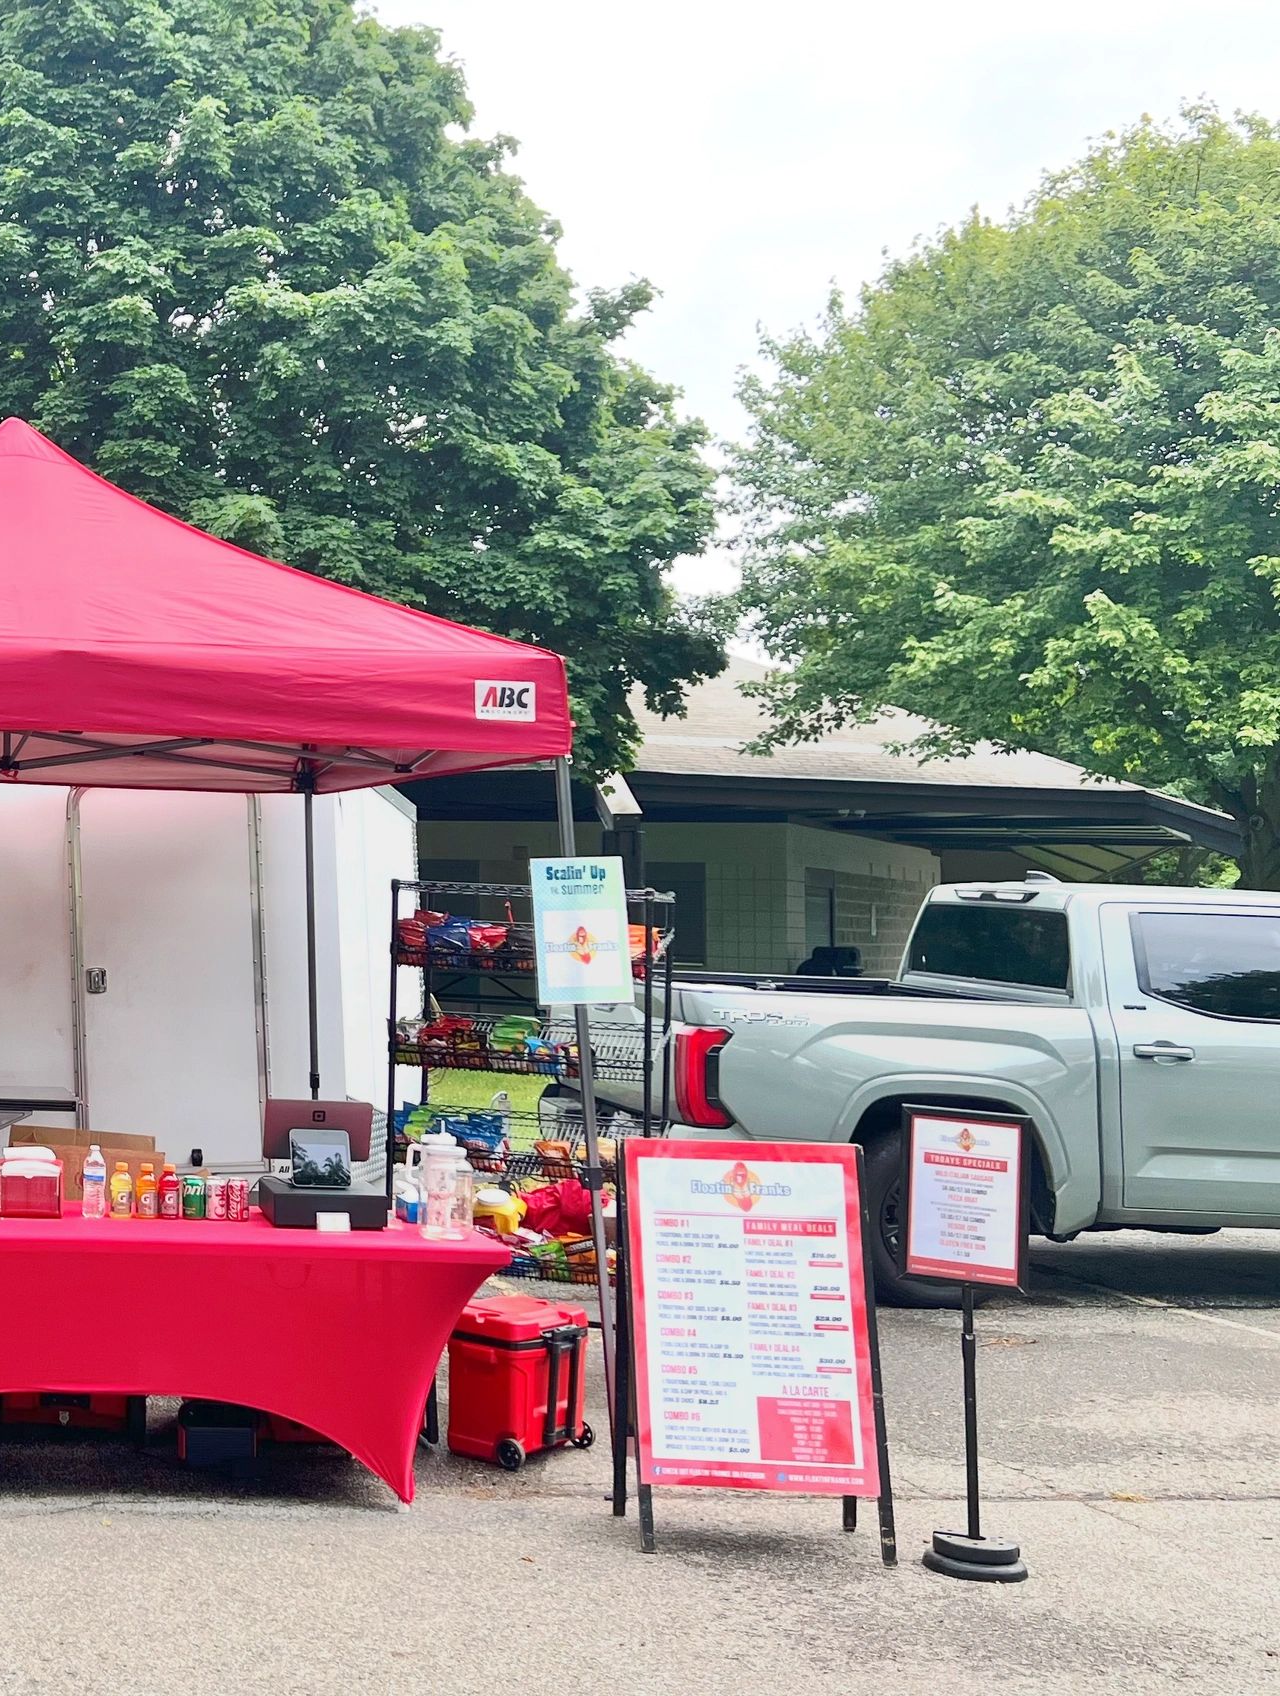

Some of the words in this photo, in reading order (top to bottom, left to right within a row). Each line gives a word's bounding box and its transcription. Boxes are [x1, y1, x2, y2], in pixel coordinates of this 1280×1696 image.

[481, 687, 530, 709] ABC
[590, 865, 607, 881] Up
[962, 1158, 1001, 1169] SPECIALS
[747, 1181, 792, 1197] Franks
[117, 1192, 127, 1203] G
[140, 1193, 150, 1204] G
[164, 1193, 174, 1204] G
[806, 1223, 835, 1233] DEALS
[789, 1385, 801, 1396] LA
[802, 1386, 830, 1398] CARTE
